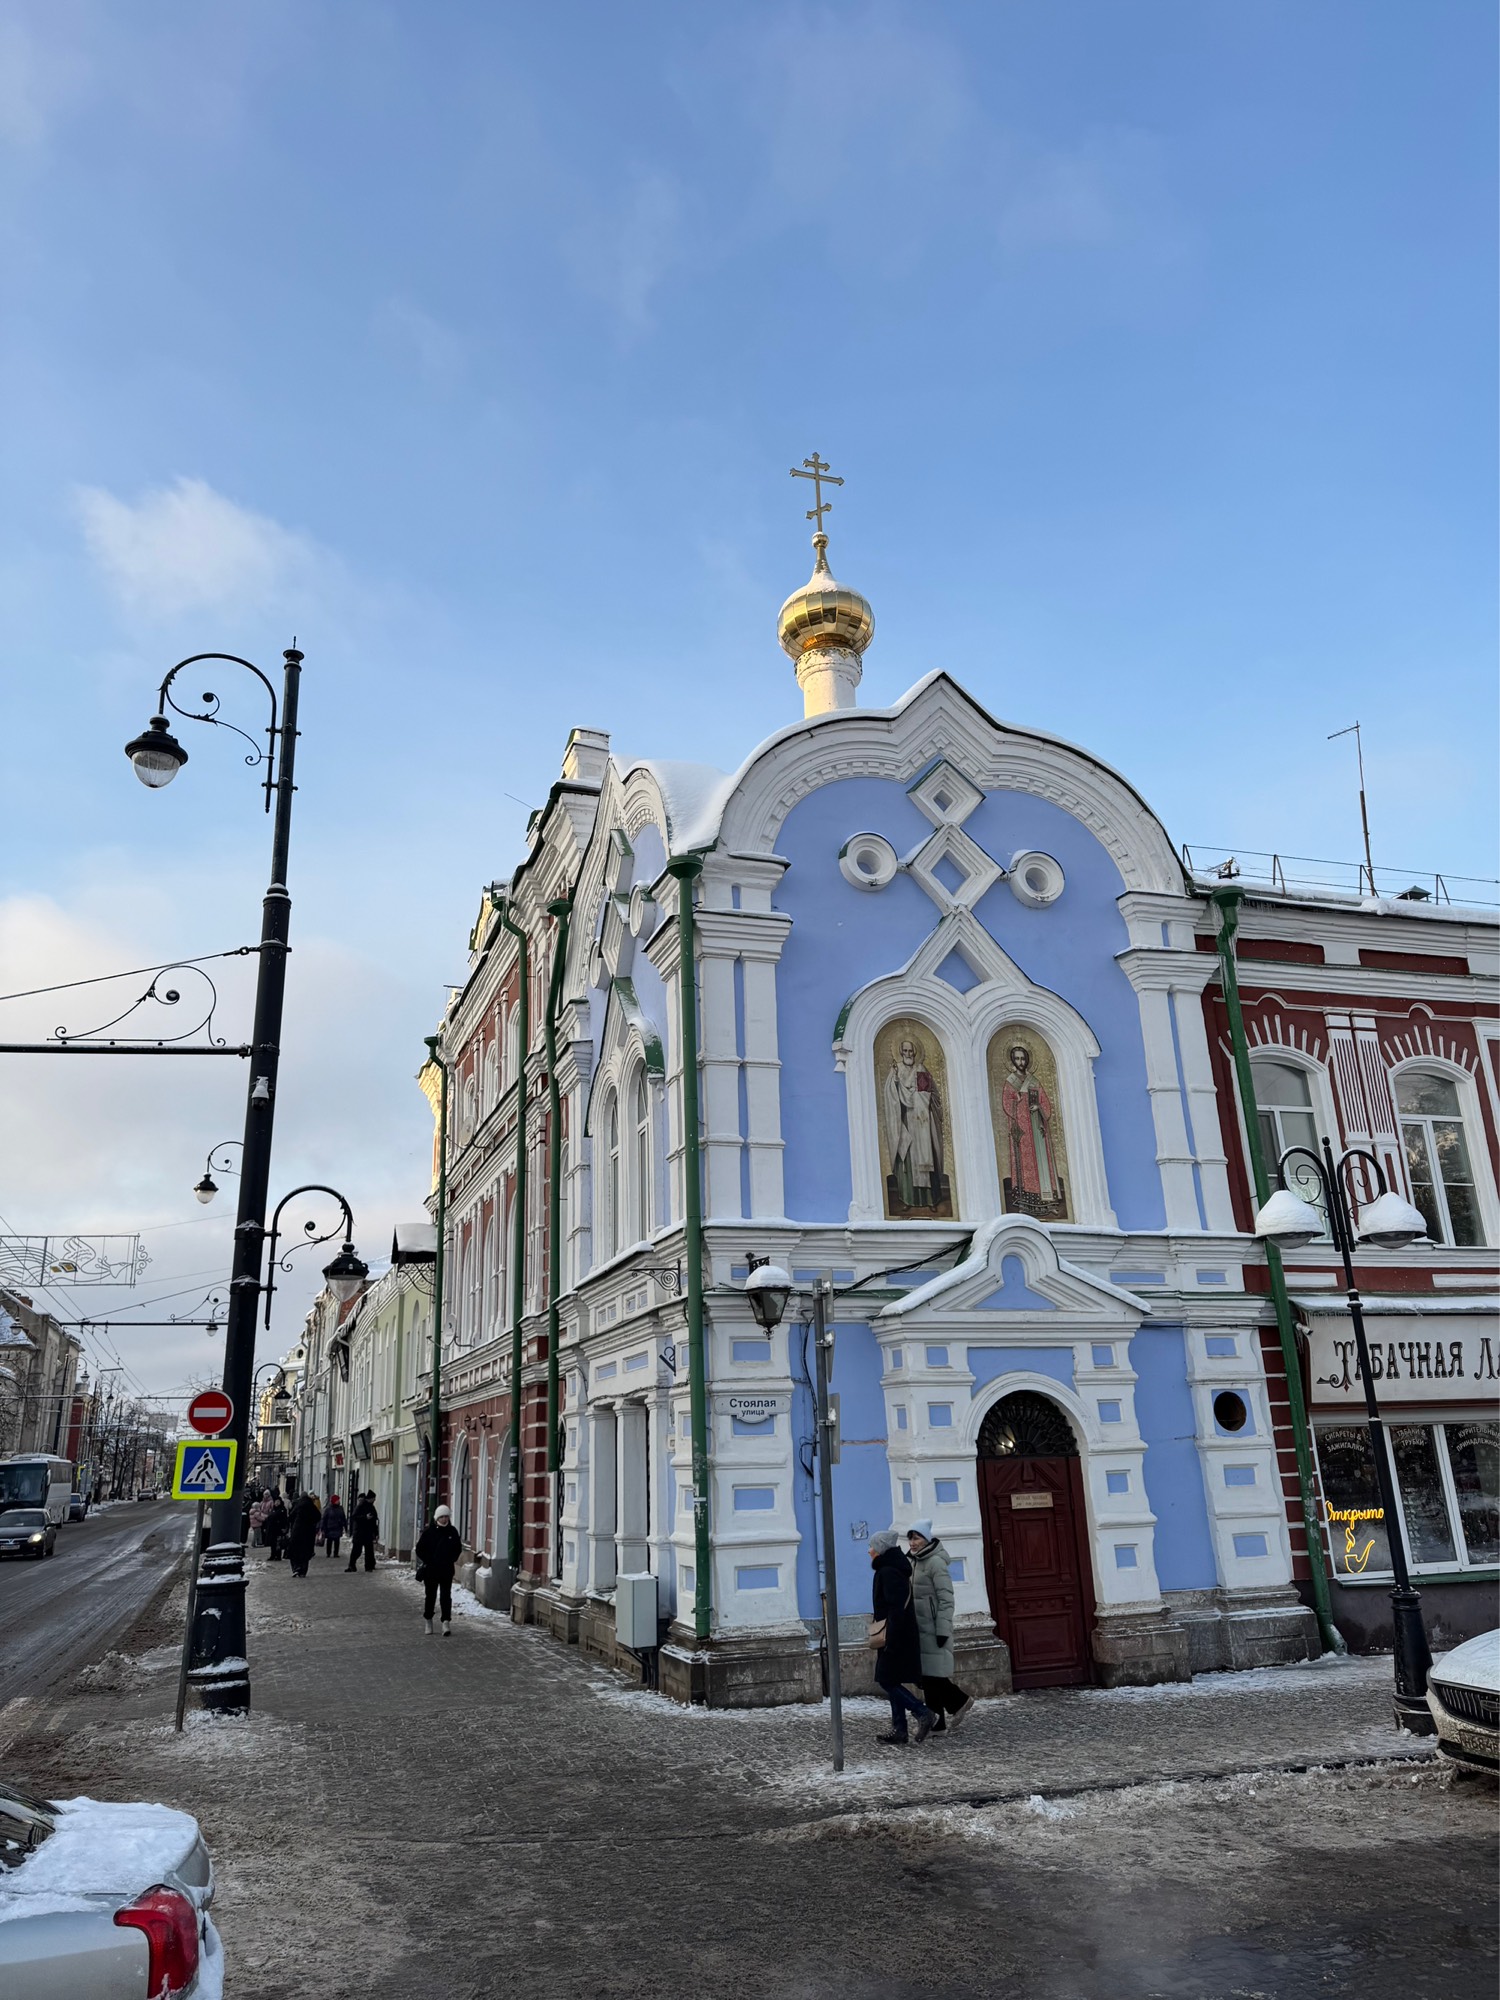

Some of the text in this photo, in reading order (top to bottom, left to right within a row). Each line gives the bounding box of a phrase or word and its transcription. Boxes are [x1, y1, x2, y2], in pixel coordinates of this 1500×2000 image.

[1474, 1337, 1500, 1381] Л
[729, 1398, 777, 1408] Стоялая
[741, 1409, 765, 1417] улица
[1324, 1430, 1356, 1441] СИГАРЕТЫ
[1326, 1441, 1365, 1453] ЗАЖИГАЛКИ
[1401, 1438, 1425, 1447] ТРУБКИ
[1324, 1500, 1384, 1530] Открыто
